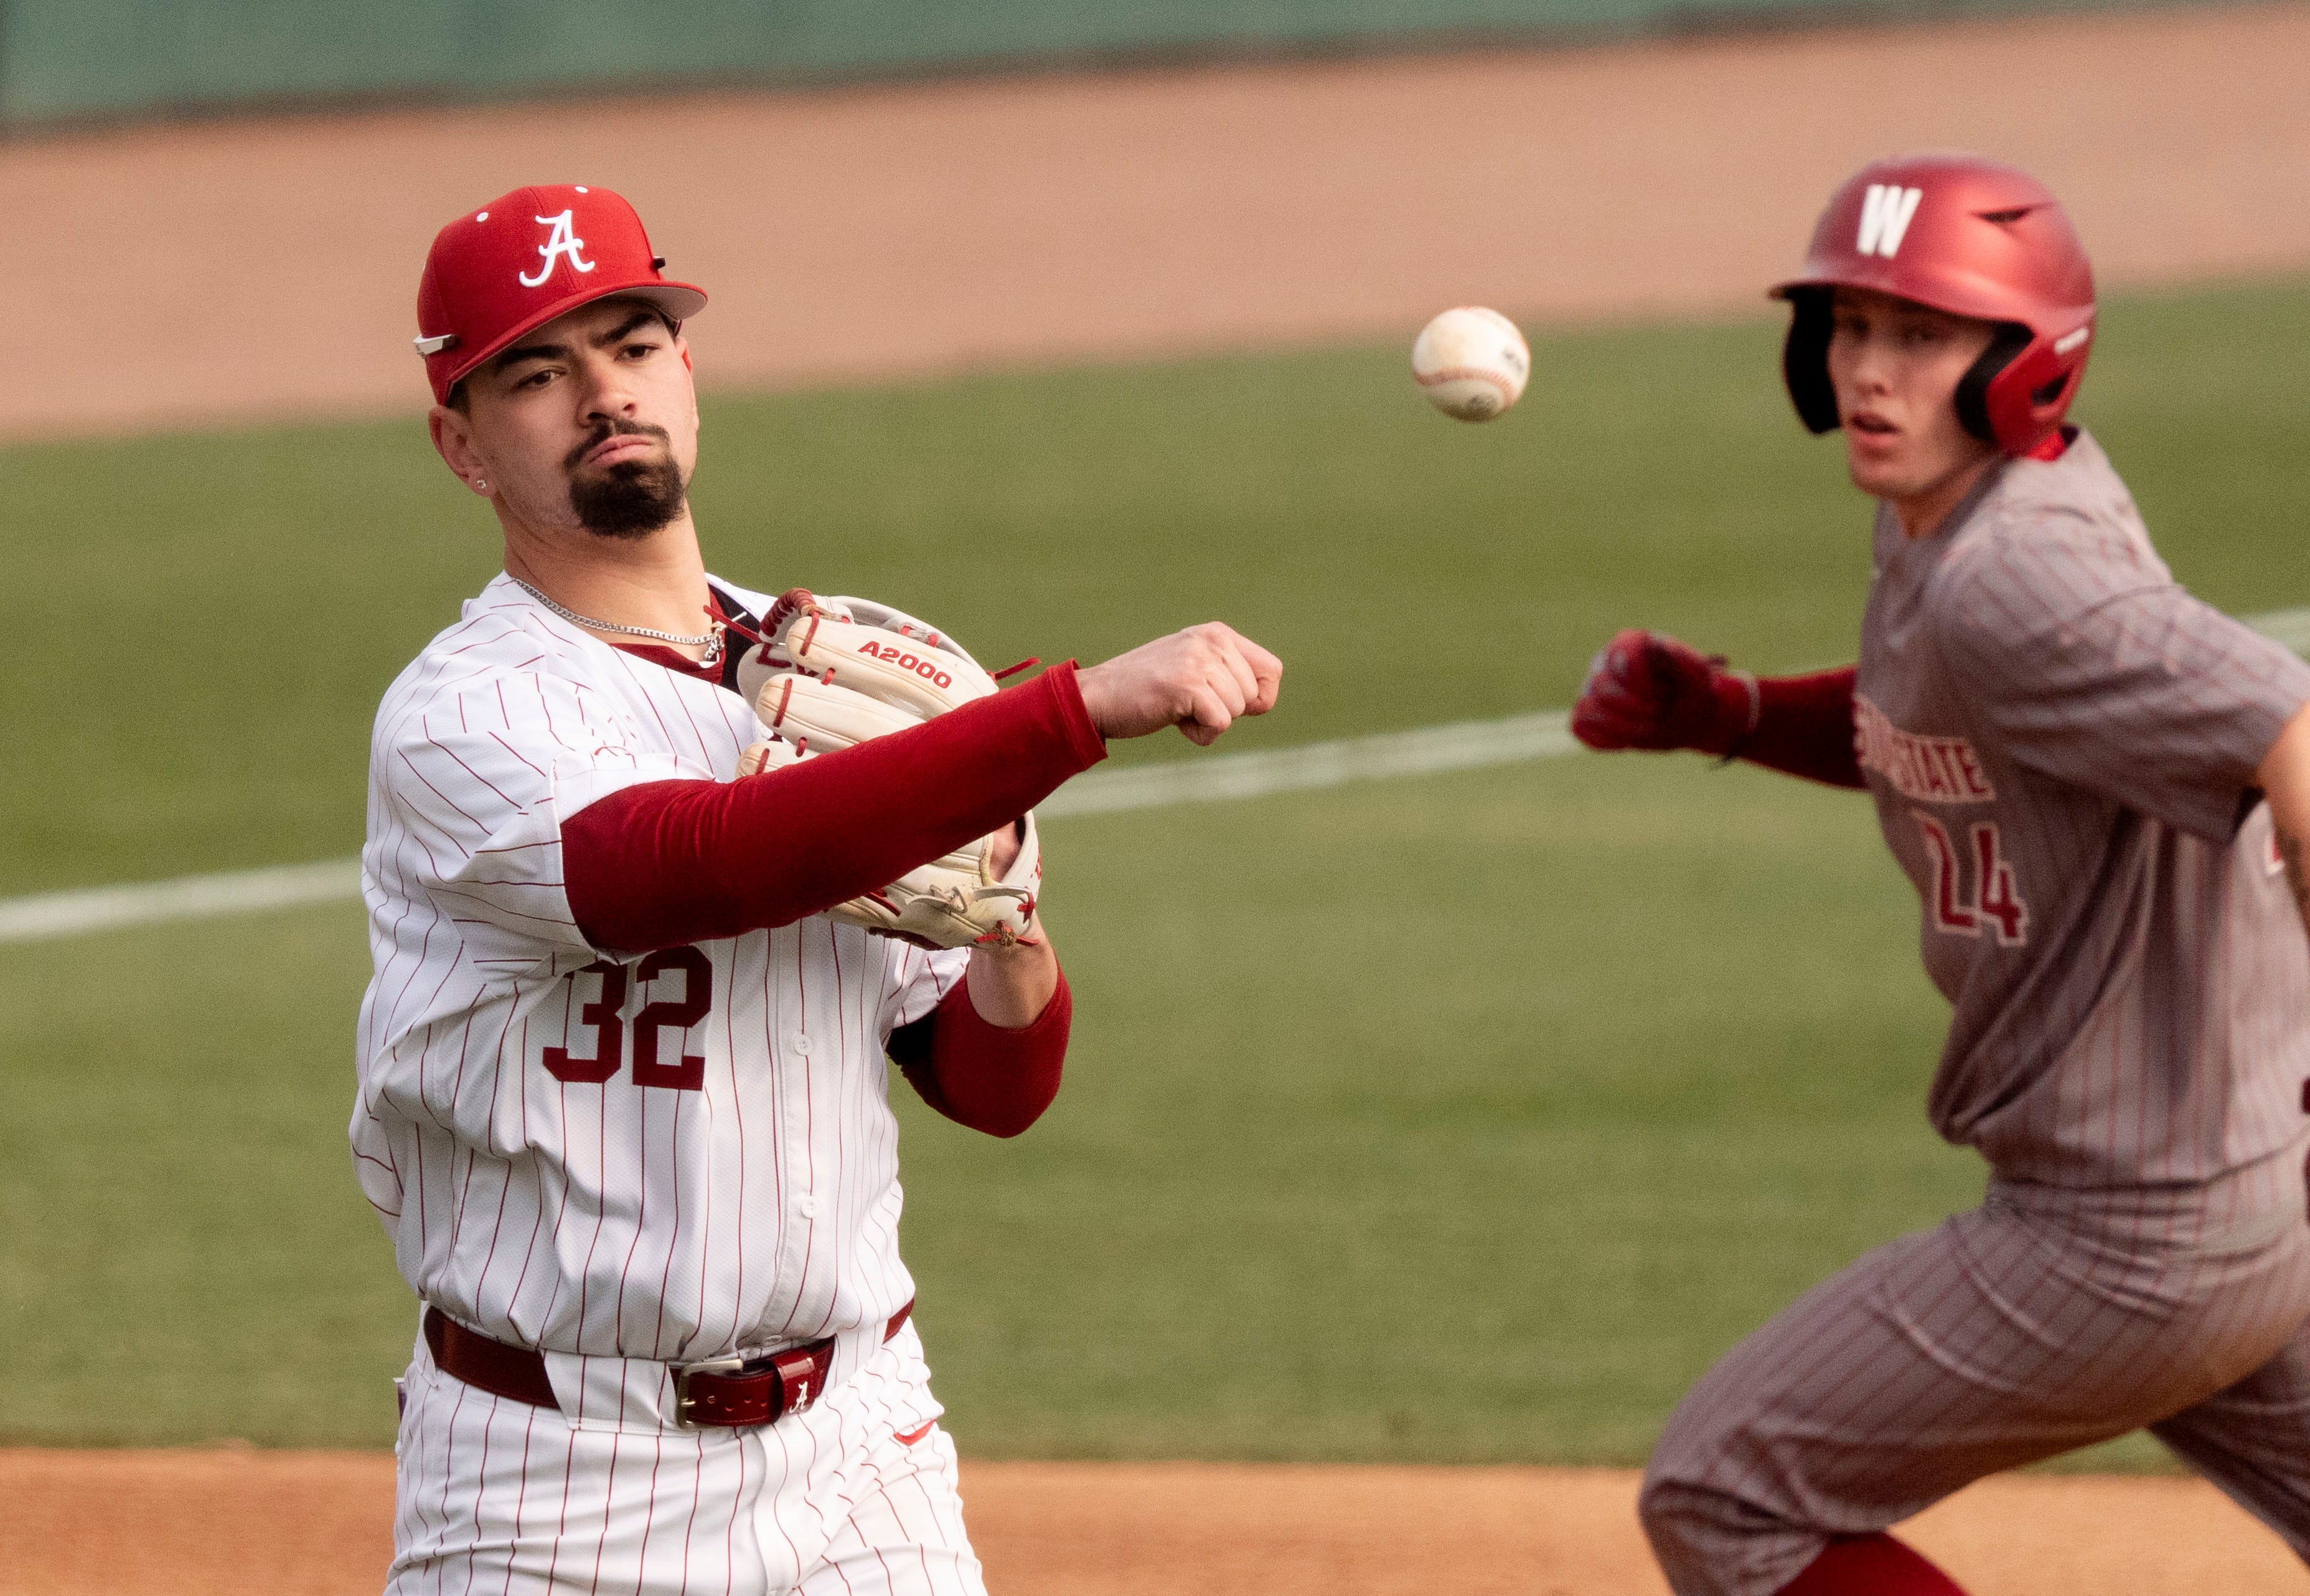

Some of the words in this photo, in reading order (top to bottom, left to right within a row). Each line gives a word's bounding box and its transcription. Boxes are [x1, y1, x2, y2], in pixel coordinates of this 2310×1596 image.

[519, 209, 595, 288] A
[1856, 184, 1923, 258] W
[857, 641, 952, 689] A2000
[1911, 807, 2031, 947] 24
[542, 944, 713, 1091] 32
[789, 1381, 809, 1414] A
